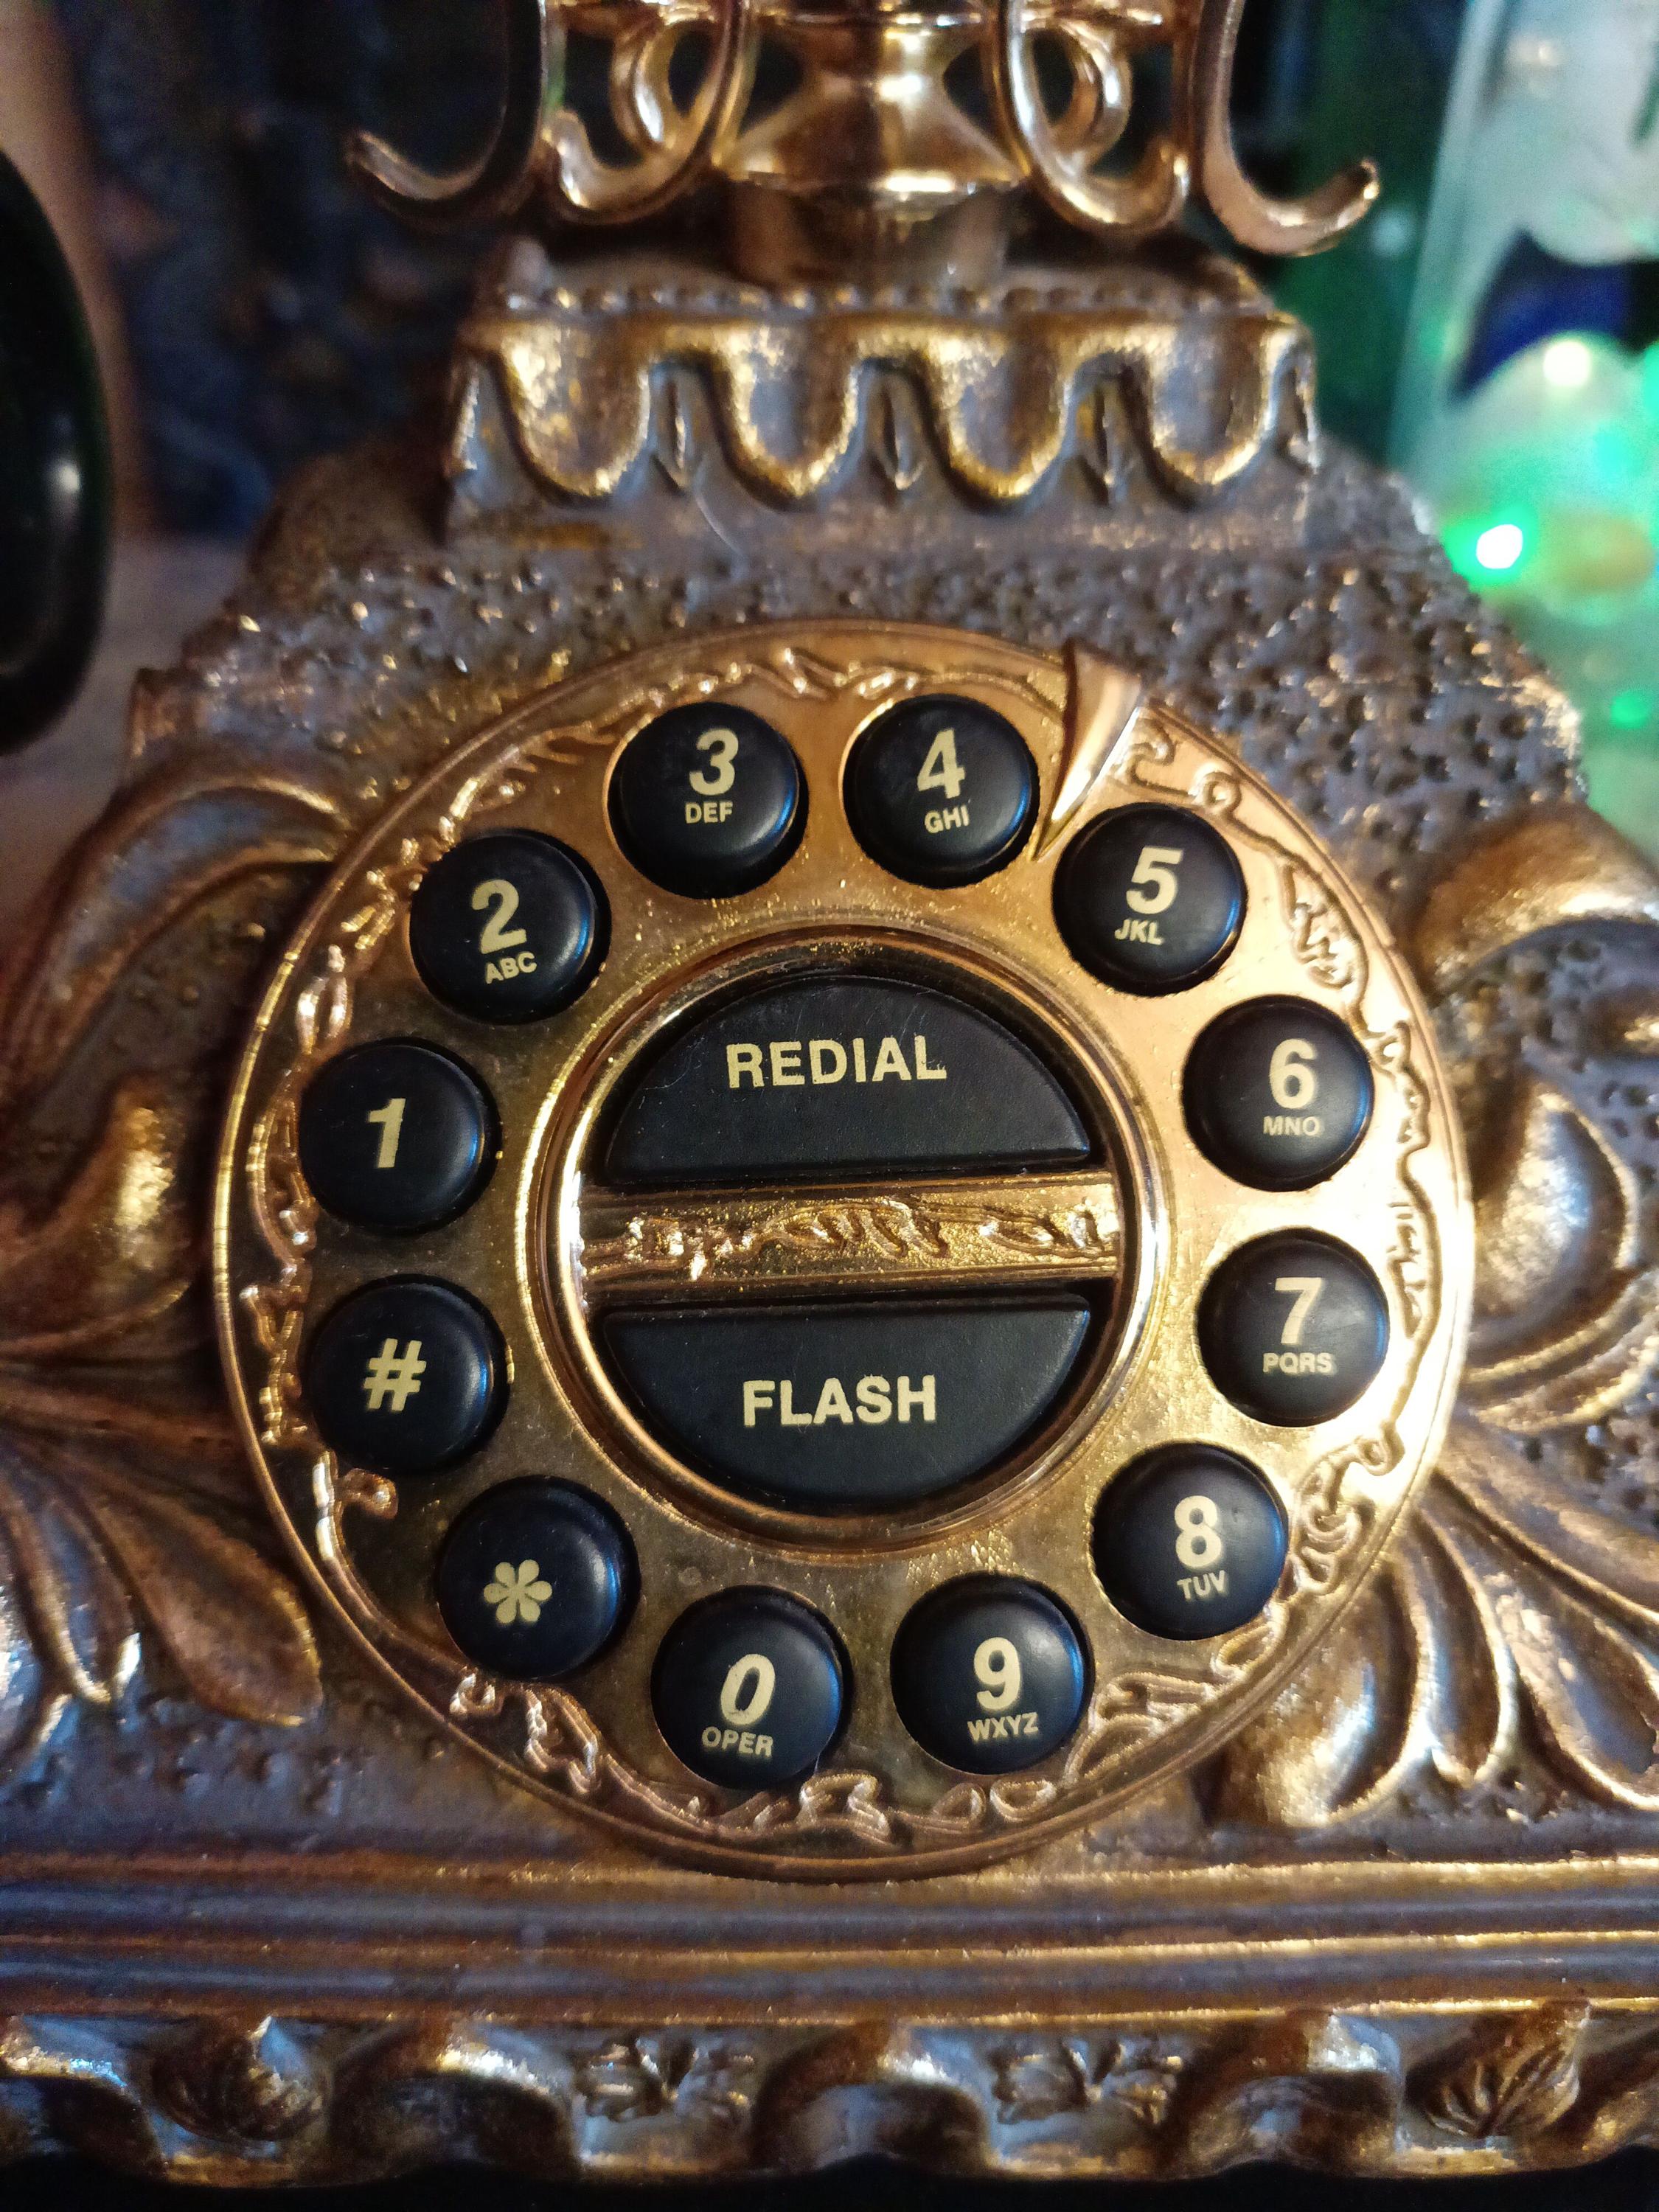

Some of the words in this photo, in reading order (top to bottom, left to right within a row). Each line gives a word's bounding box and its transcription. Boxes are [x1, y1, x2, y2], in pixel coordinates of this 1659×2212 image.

[689, 729, 738, 795] 3
[917, 729, 965, 799] 4
[686, 801, 733, 823] DEF
[925, 805, 969, 833] GHI
[1127, 847, 1183, 914] 5
[473, 880, 528, 954] 2
[1115, 919, 1164, 945] JKL
[484, 950, 537, 984] ABC
[726, 1035, 947, 1088] REDIAL
[1270, 1039, 1315, 1109] 6
[369, 1099, 406, 1168] 1
[1264, 1116, 1322, 1137] MNO
[1276, 1277, 1322, 1345] 7
[1263, 1352, 1332, 1374] PQRS
[743, 1374, 936, 1426] FLASH
[1175, 1495, 1223, 1570] 8
[1178, 1570, 1228, 1599] TUV
[720, 1654, 775, 1725] 0
[974, 1635, 1022, 1708] 9
[702, 1726, 773, 1758] OPER
[967, 1712, 1038, 1742] WXYZ
